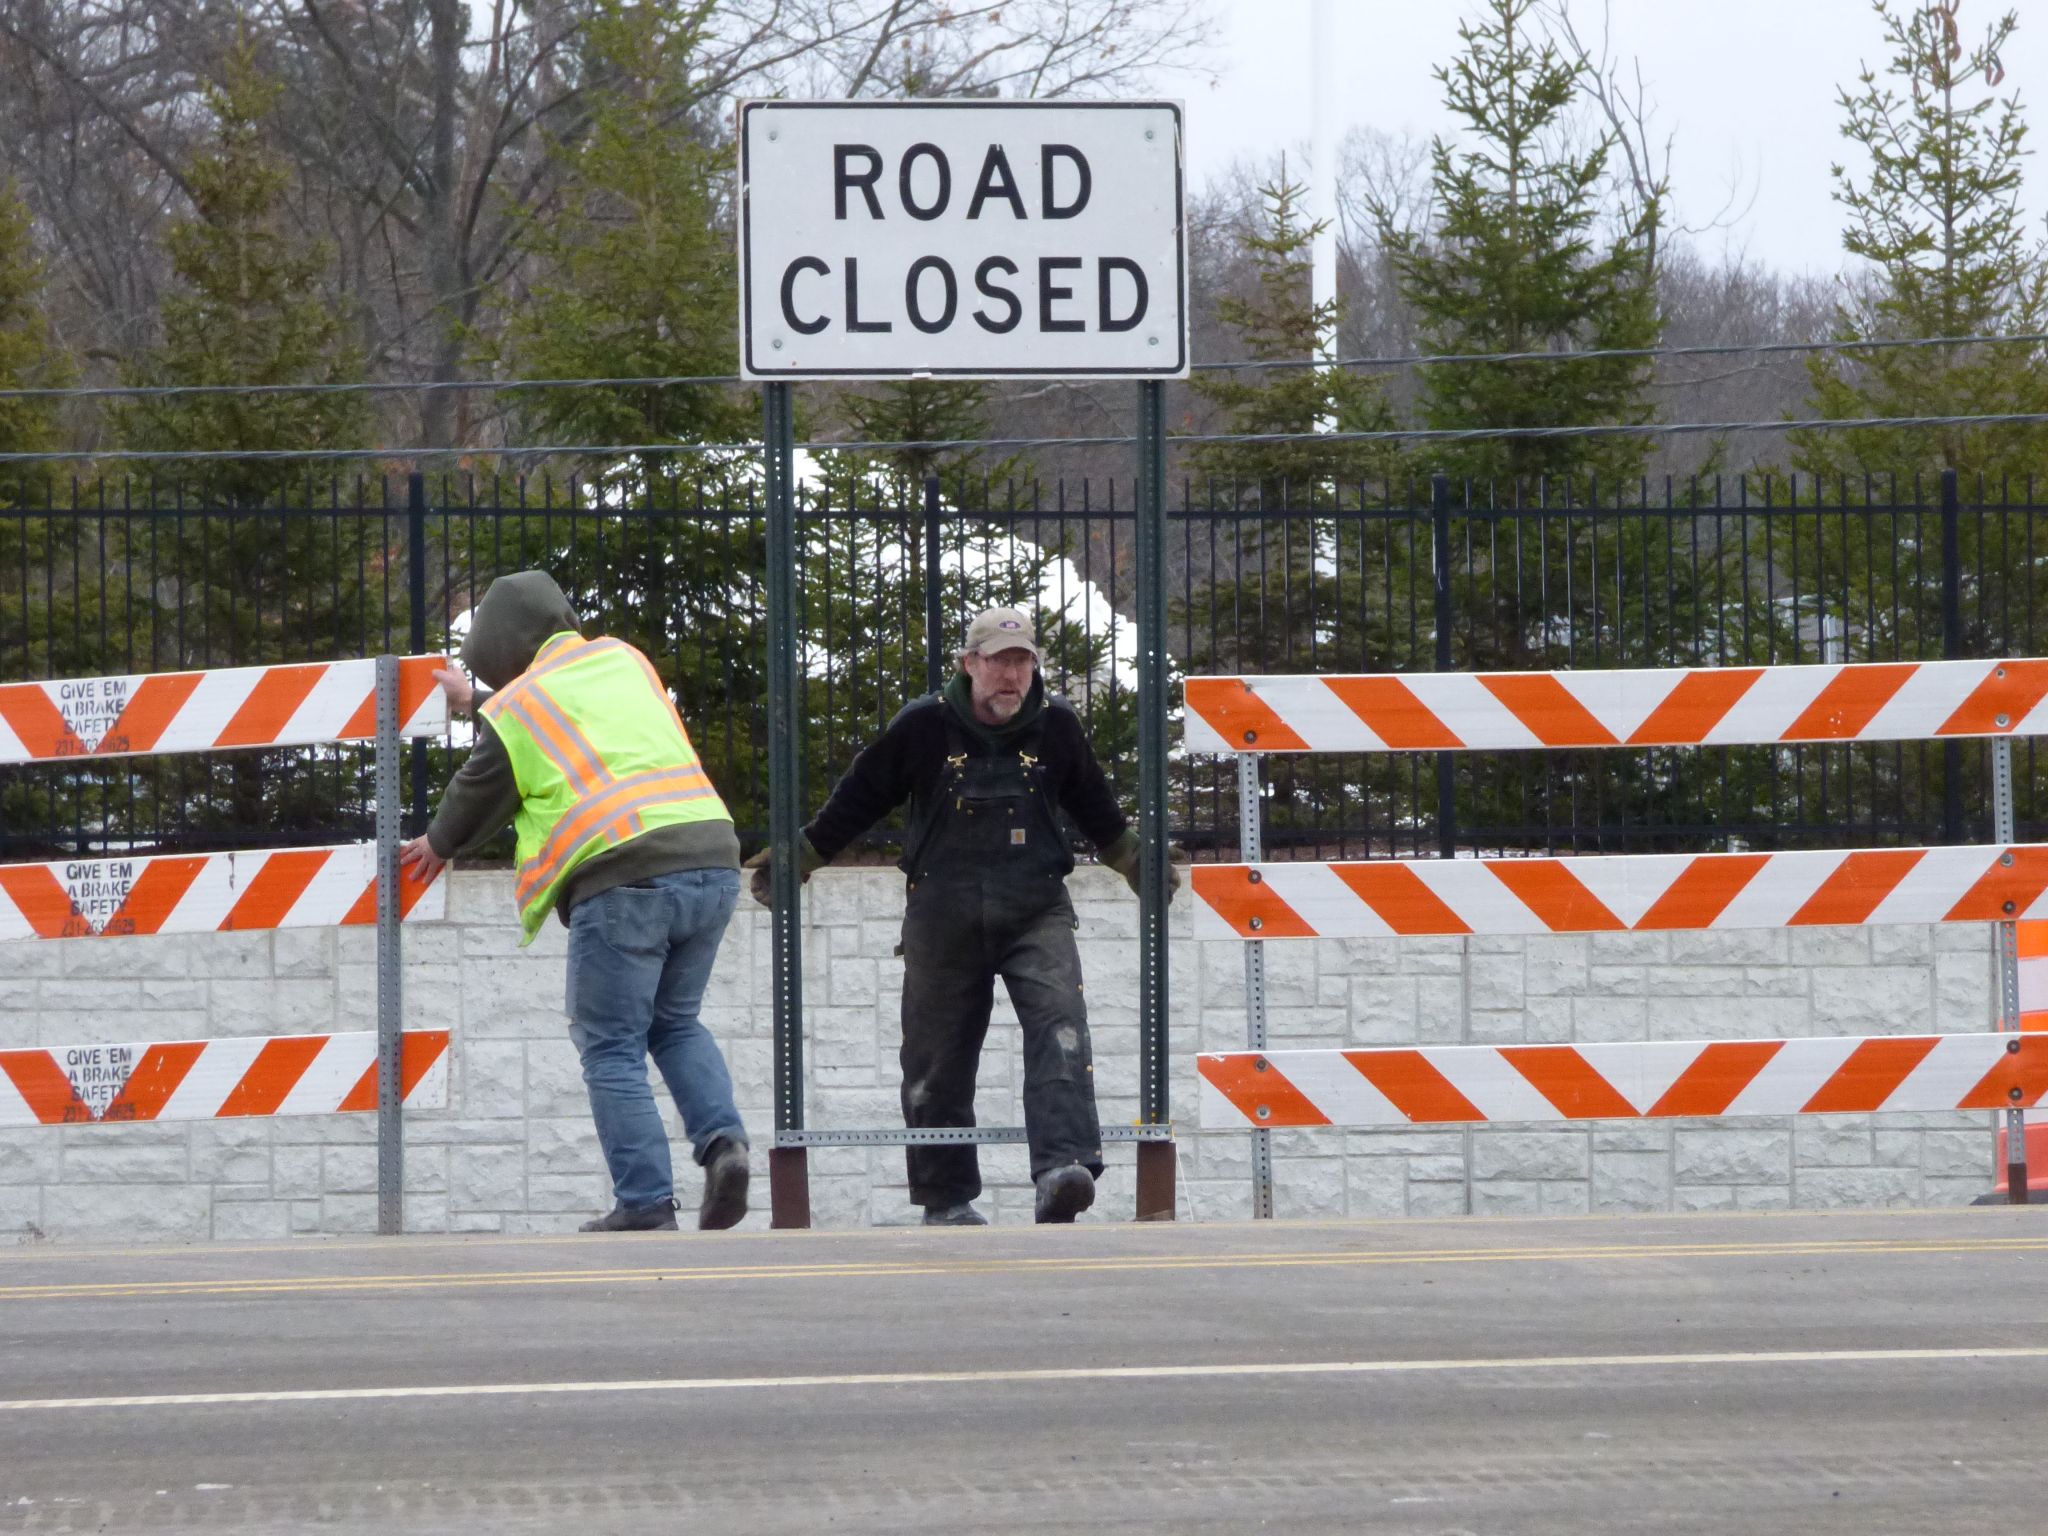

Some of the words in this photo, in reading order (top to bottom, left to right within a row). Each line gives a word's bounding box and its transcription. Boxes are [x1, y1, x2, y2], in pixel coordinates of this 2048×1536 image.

[834, 142, 1092, 221] ROAD
[780, 255, 1149, 335] CLOSED
[60, 682, 94, 699] GIVE
[100, 680, 127, 696] 'EM
[61, 704, 71, 717] A
[75, 698, 125, 716] BRAKE
[64, 717, 120, 735] SAFETY
[66, 863, 101, 880] GIVE
[106, 862, 133, 878] 'EM
[68, 886, 77, 898] A
[82, 880, 131, 897] BRAKE
[71, 899, 126, 916] SAFETY
[67, 1049, 101, 1066] GIVE
[106, 1047, 132, 1063] 'EM
[68, 1070, 78, 1083] A
[83, 1065, 130, 1082] BRAKE
[71, 1084, 126, 1102] SAFETY
